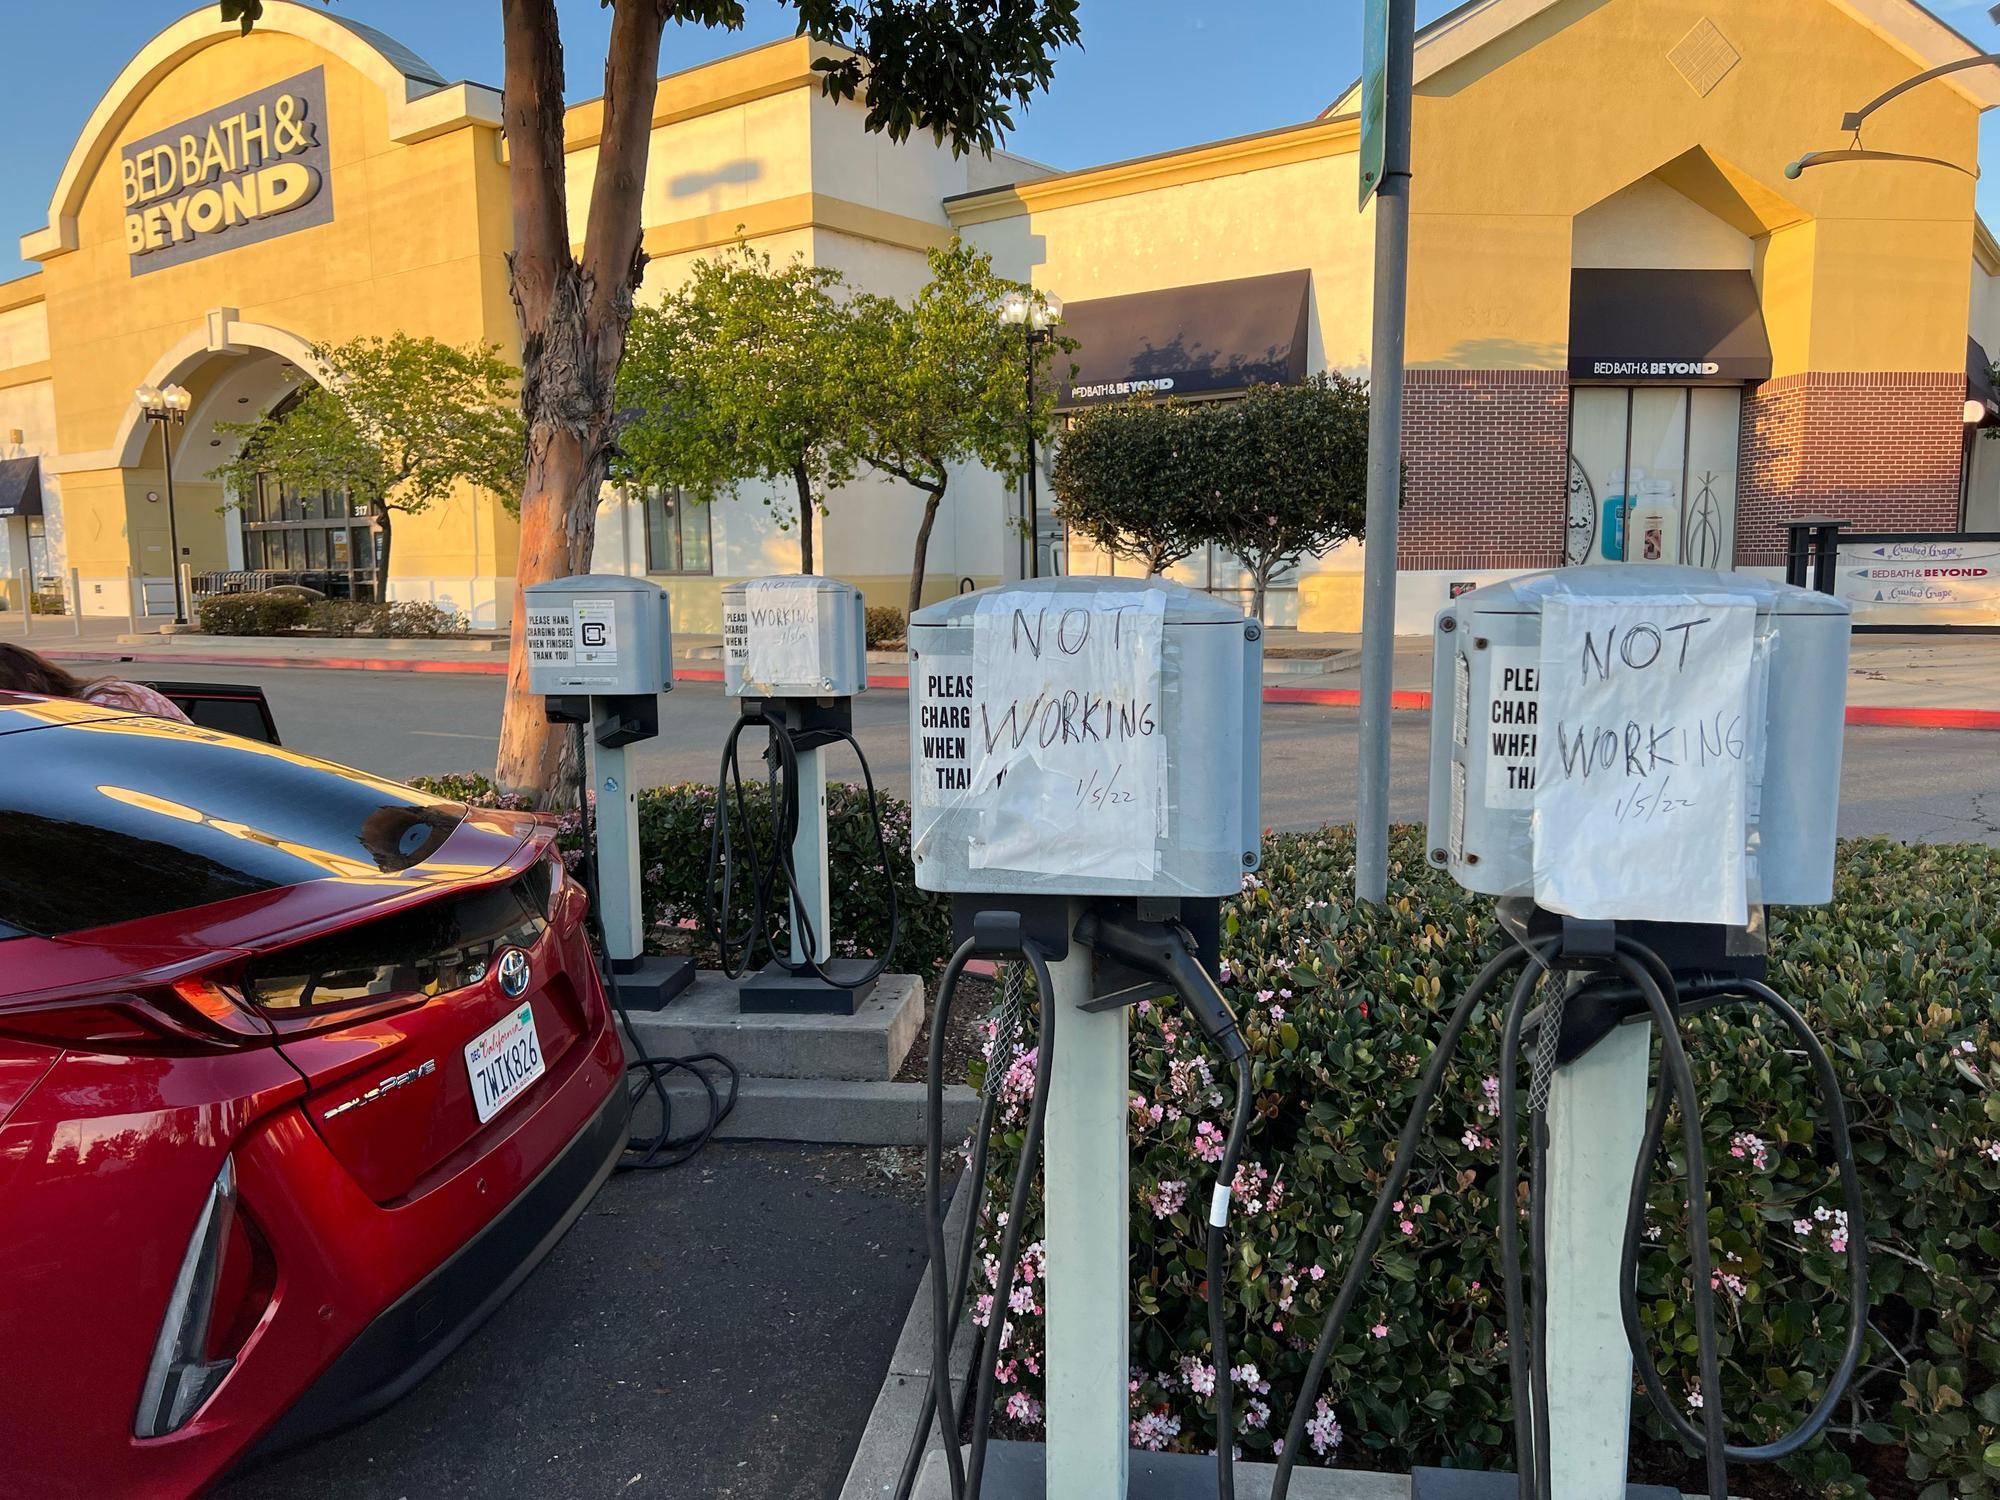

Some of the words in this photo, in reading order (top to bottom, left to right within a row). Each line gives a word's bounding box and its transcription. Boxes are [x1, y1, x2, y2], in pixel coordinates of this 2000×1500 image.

[121, 144, 178, 207] BED
[180, 104, 269, 187] BATH
[273, 94, 308, 154] &
[124, 162, 312, 256] BEYOND
[1594, 362, 1613, 374] BED
[1613, 362, 1640, 374] BATH
[1640, 362, 1649, 374] &
[1650, 362, 1719, 374] BEYOND
[1087, 384, 1108, 397] BATH
[1108, 383, 1116, 395] &
[1116, 378, 1174, 394] BEYOND
[354, 505, 368, 516] 317
[1893, 543, 1927, 557] Crushed
[1928, 543, 1957, 559] Grape
[1872, 569, 1890, 578] BED
[1890, 569, 1914, 578] BATH
[1914, 569, 1922, 578] &
[1924, 568, 1988, 577] BEYOND
[1890, 586, 1923, 599] Crushed
[1925, 586, 1953, 601] Grape
[529, 616, 550, 625] PLEASE
[552, 616, 569, 625] HANG
[751, 608, 814, 628] WORKING
[528, 628, 555, 637] CHARGING
[557, 628, 573, 637] HOSE
[726, 637, 742, 646] WHEN
[1013, 604, 1145, 661] NOT
[529, 640, 544, 648] WHEN
[546, 640, 573, 648] FINISHED
[731, 649, 749, 658] THA
[1581, 617, 1712, 686] NOT
[533, 651, 553, 660] THANK
[555, 651, 569, 660] YOU!
[980, 690, 1156, 755] WORKING
[923, 736, 965, 759] WHEN
[1557, 710, 1744, 779] WORKING
[1076, 764, 1136, 811] 1/5/22
[1615, 775, 1697, 824] 1/5/22
[480, 1023, 523, 1058] California
[477, 1030, 538, 1106] 7WIK826
